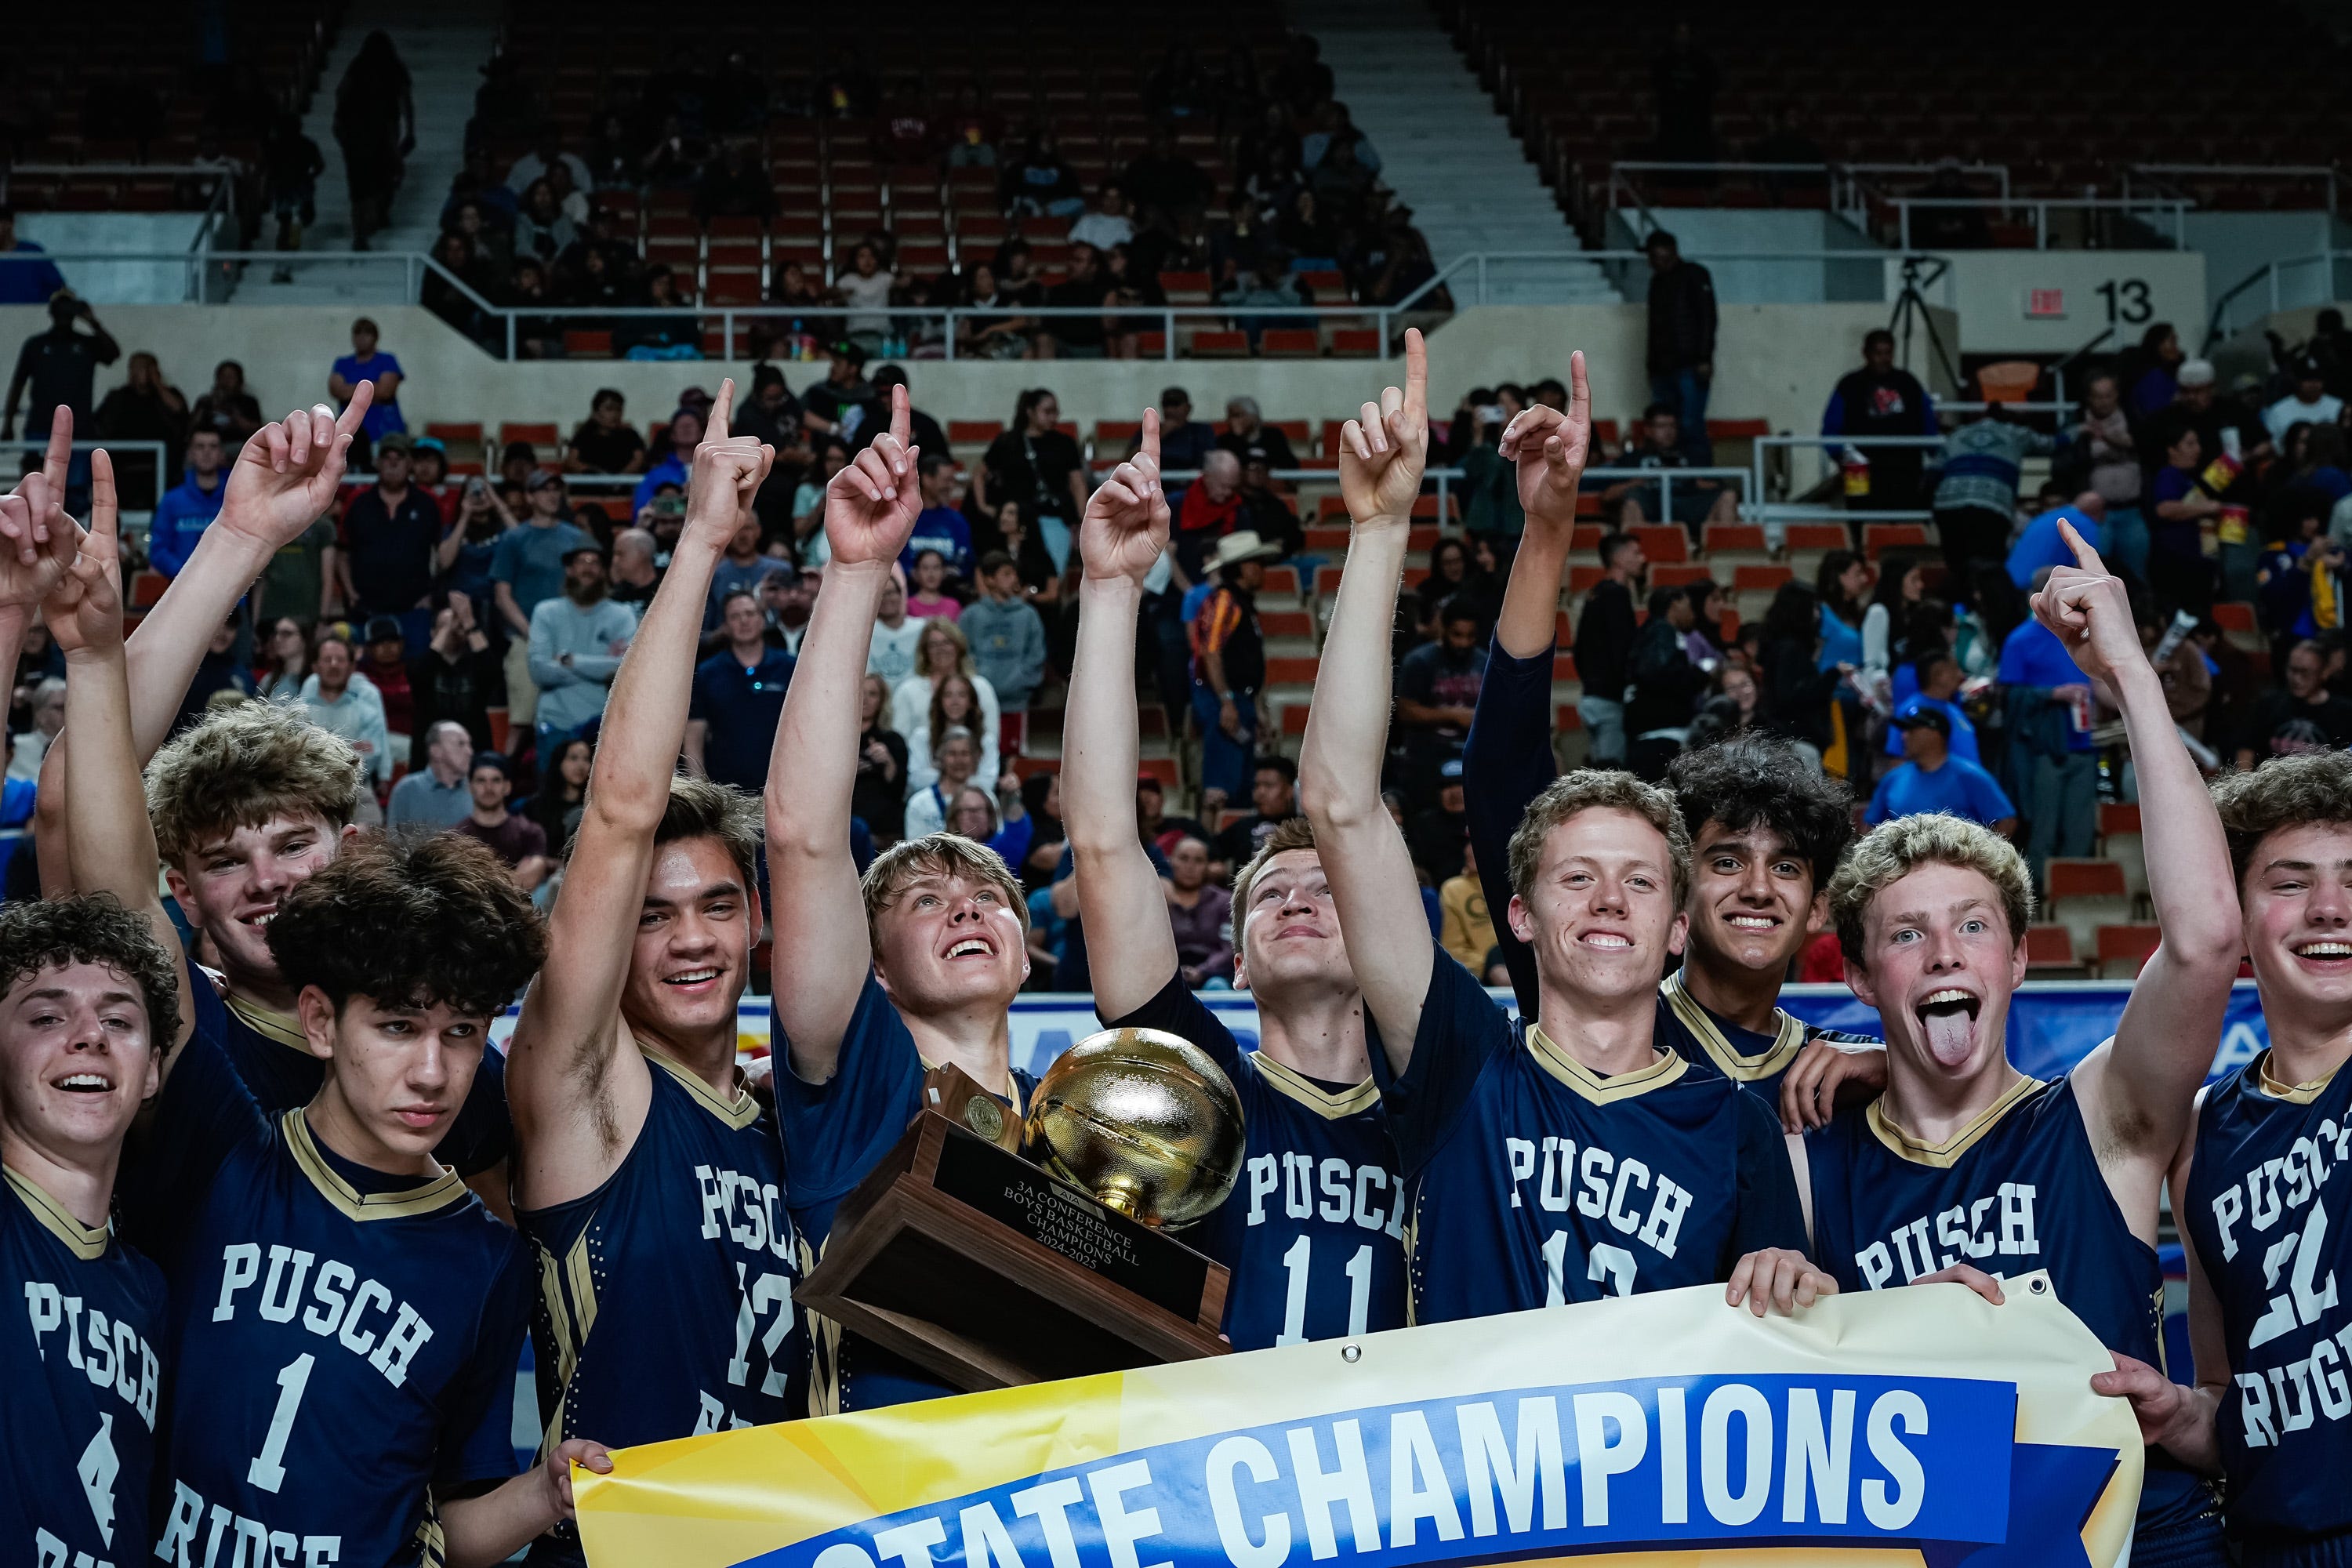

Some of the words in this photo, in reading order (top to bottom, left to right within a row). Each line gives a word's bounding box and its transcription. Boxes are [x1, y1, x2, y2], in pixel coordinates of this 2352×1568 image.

[2096, 280, 2153, 323] 13
[695, 1165, 797, 1271] PUSC
[1004, 1186, 1043, 1214] BOYS
[1046, 1208, 1140, 1266] BASKETBALL
[1017, 1181, 1034, 1197] 3A
[1037, 1192, 1133, 1249] CONFERENCE
[1026, 1213, 1112, 1265] CHAMPIONS
[1036, 1231, 1098, 1269] 2024-2025
[1060, 1191, 1080, 1205] AIA
[1506, 1136, 1693, 1259] PUSCH
[1855, 1182, 2039, 1290] PUSCH
[212, 1243, 434, 1388] PUSCH
[728, 1261, 795, 1399] 12
[1276, 1234, 1373, 1347] 11
[247, 1352, 315, 1494] 1
[811, 1458, 1175, 1568] TATE
[1205, 1384, 1929, 1568] CHAMPIONS
